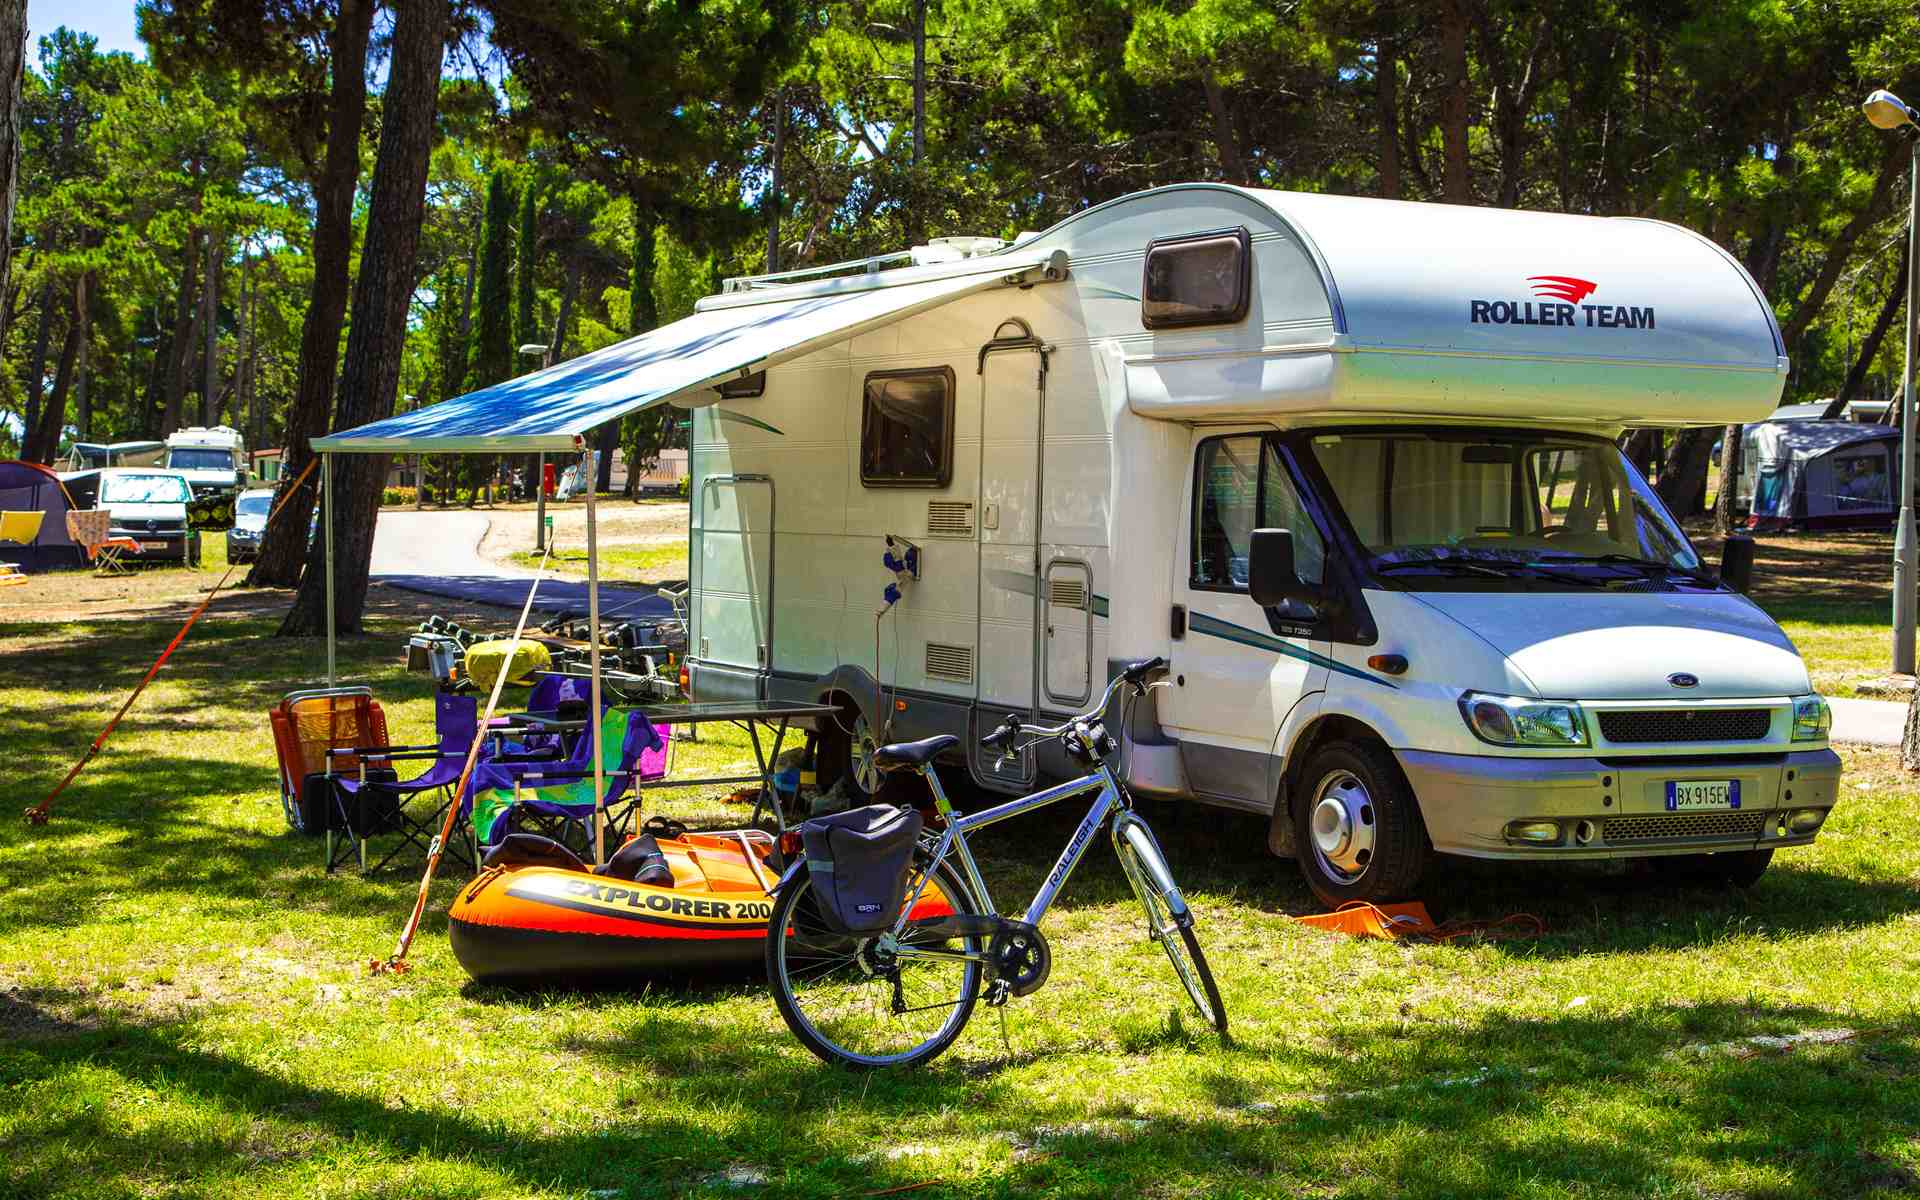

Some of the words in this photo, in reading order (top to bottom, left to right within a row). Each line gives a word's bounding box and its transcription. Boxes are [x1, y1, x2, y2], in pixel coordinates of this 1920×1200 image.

[1470, 300, 1576, 327] ROLLER
[1582, 304, 1656, 330] TEAM
[1677, 786, 1692, 806] BX
[1048, 818, 1094, 888] RALEIGH
[566, 879, 731, 920] EXPLORER
[735, 902, 770, 919] 200
